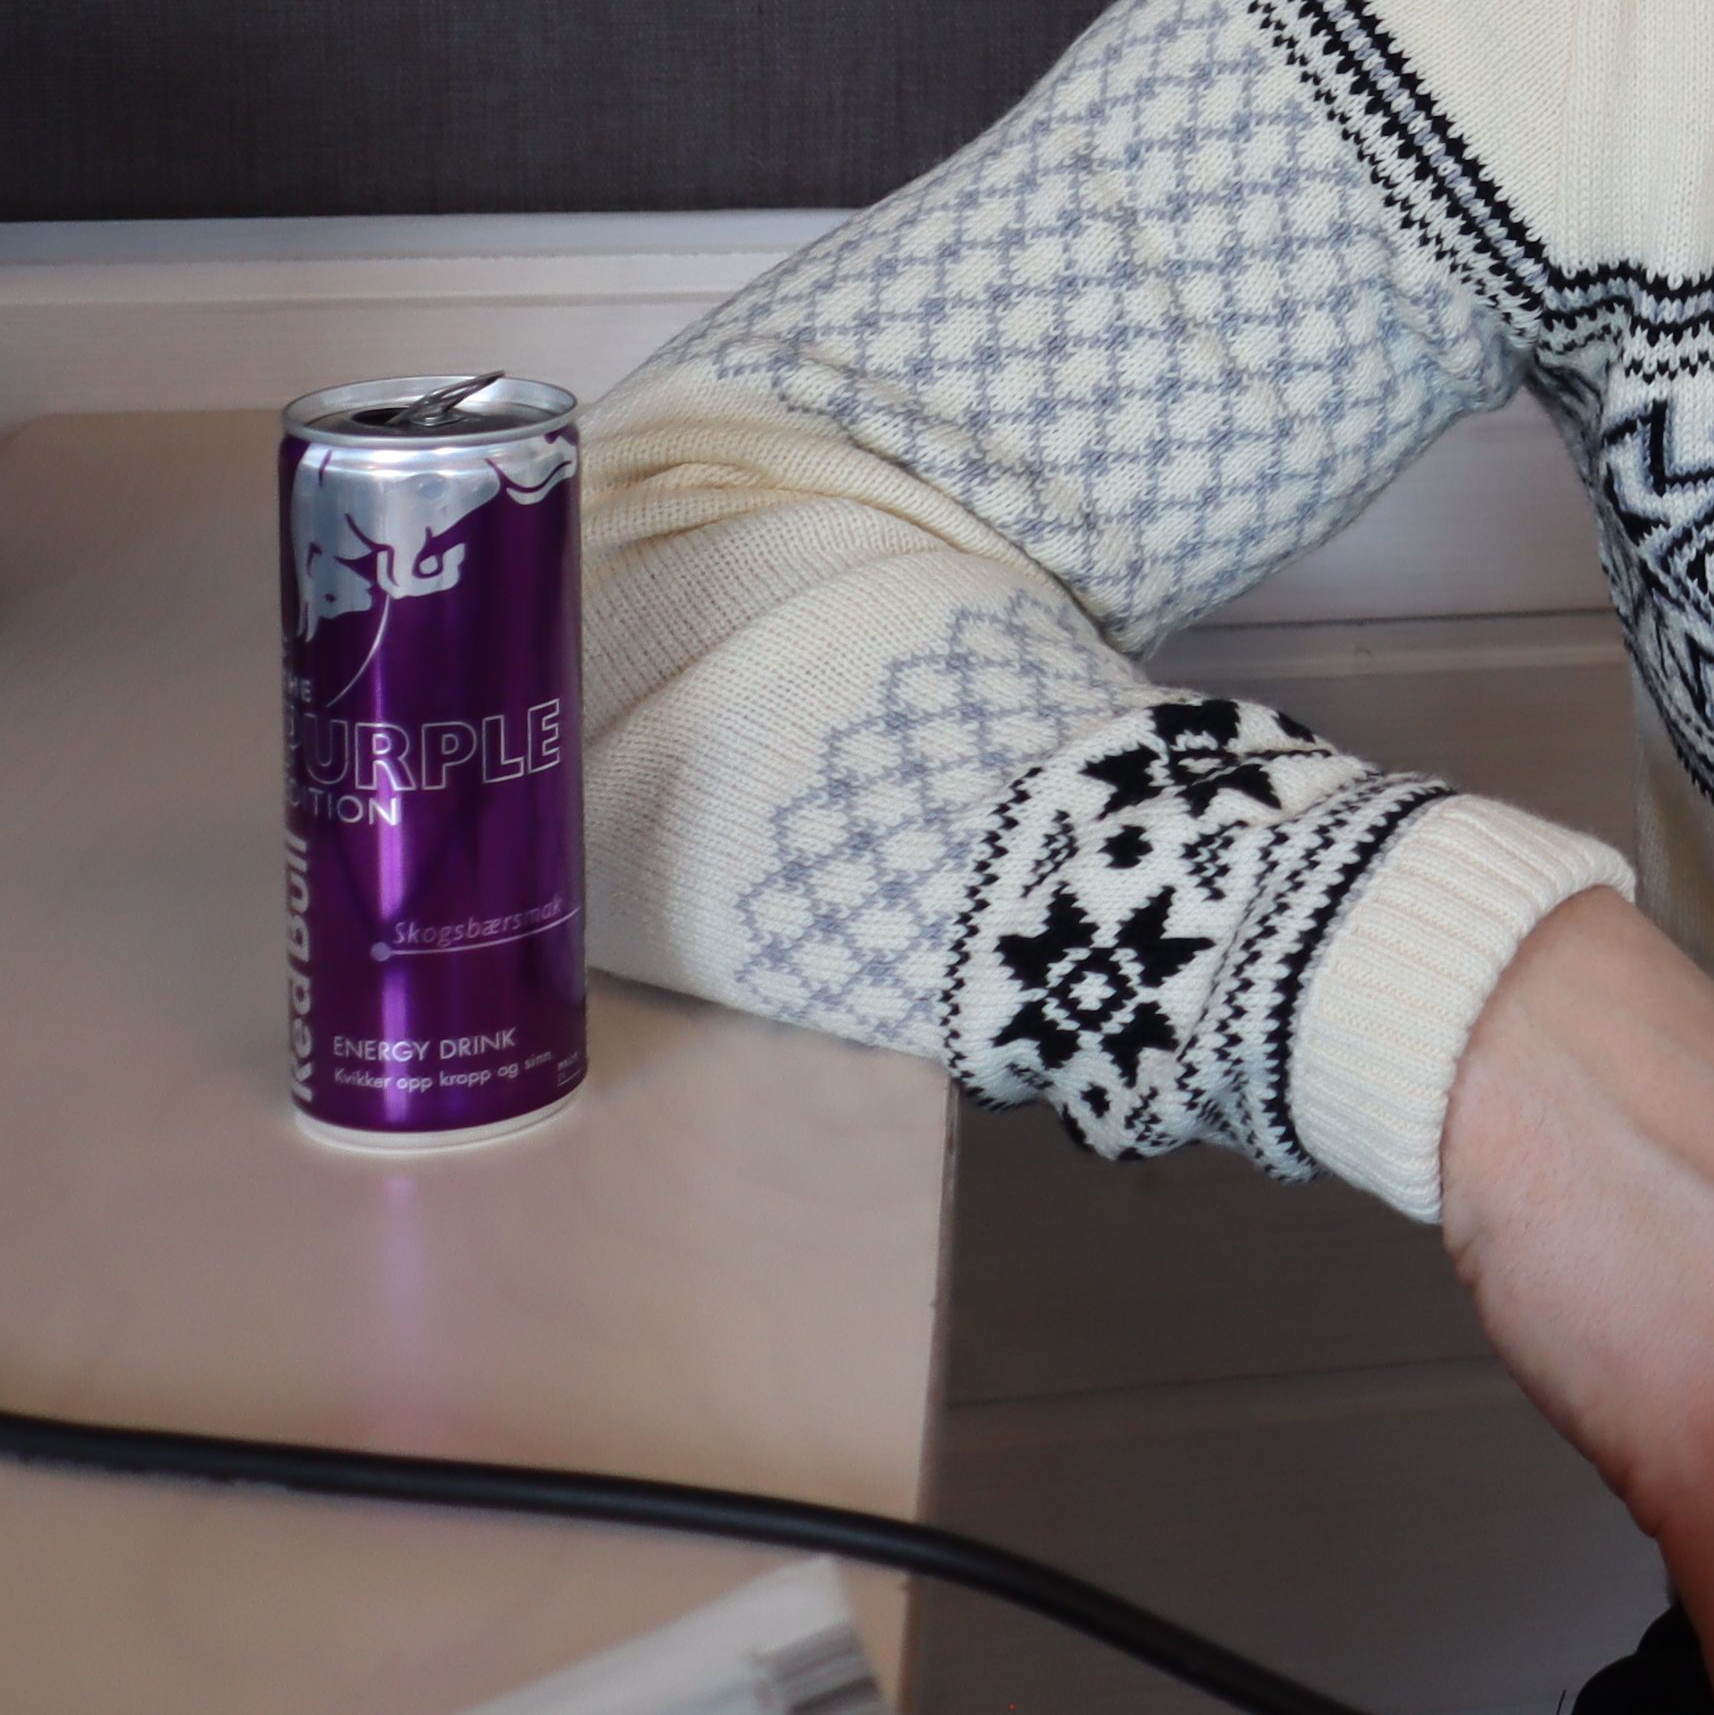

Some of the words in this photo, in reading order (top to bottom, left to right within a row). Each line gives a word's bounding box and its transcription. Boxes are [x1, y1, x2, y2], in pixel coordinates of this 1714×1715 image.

[392, 894, 564, 949] Skogsbærsmak
[333, 1035, 430, 1062] ENERGY
[439, 1027, 518, 1060] DRINK
[334, 1068, 390, 1089] Kvikker
[396, 1075, 434, 1092] opp
[439, 1068, 492, 1090] kropp
[497, 1061, 520, 1079] og
